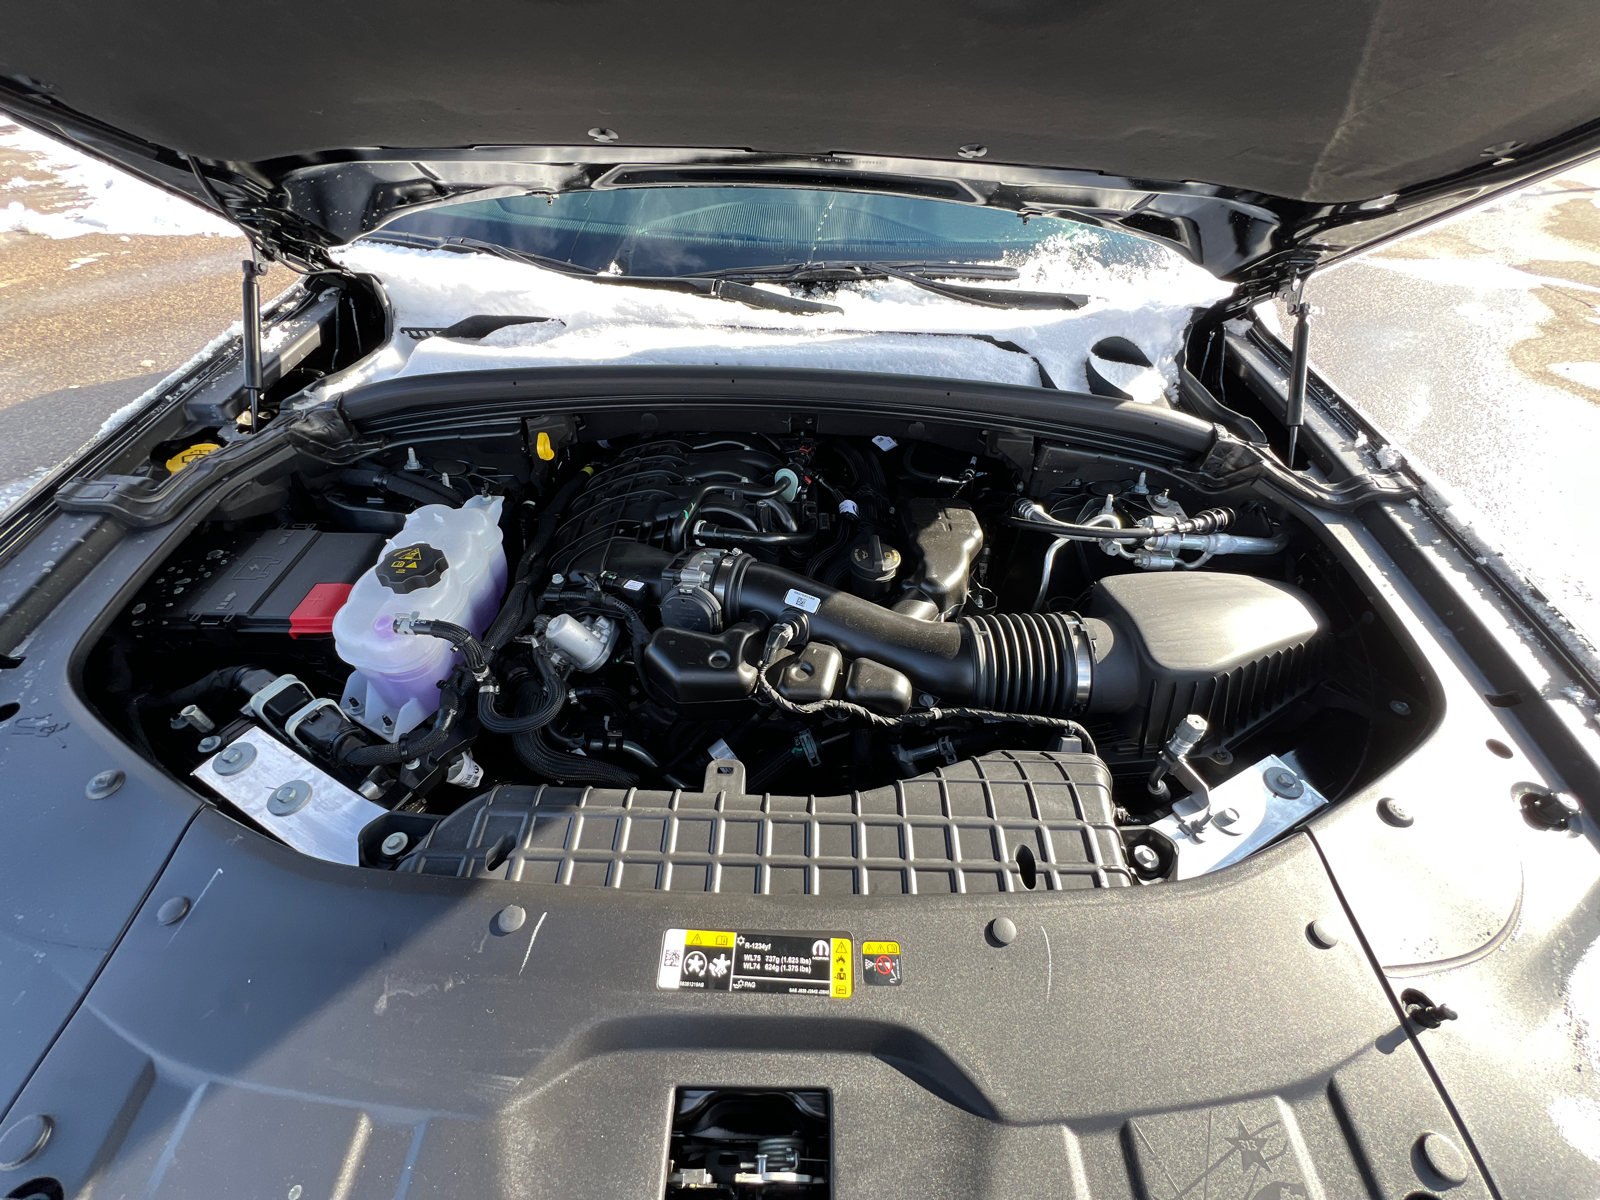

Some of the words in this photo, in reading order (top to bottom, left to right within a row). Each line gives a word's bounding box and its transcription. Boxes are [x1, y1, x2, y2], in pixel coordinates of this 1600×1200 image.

[744, 942, 772, 952] R-1234yf
[743, 954, 761, 962] WL75
[765, 955, 780, 964] 737g
[799, 957, 812, 966] lbs)
[743, 962, 761, 970] WL74
[764, 963, 780, 972] 624g
[780, 964, 799, 973] (1.375
[799, 965, 812, 974] lbs)
